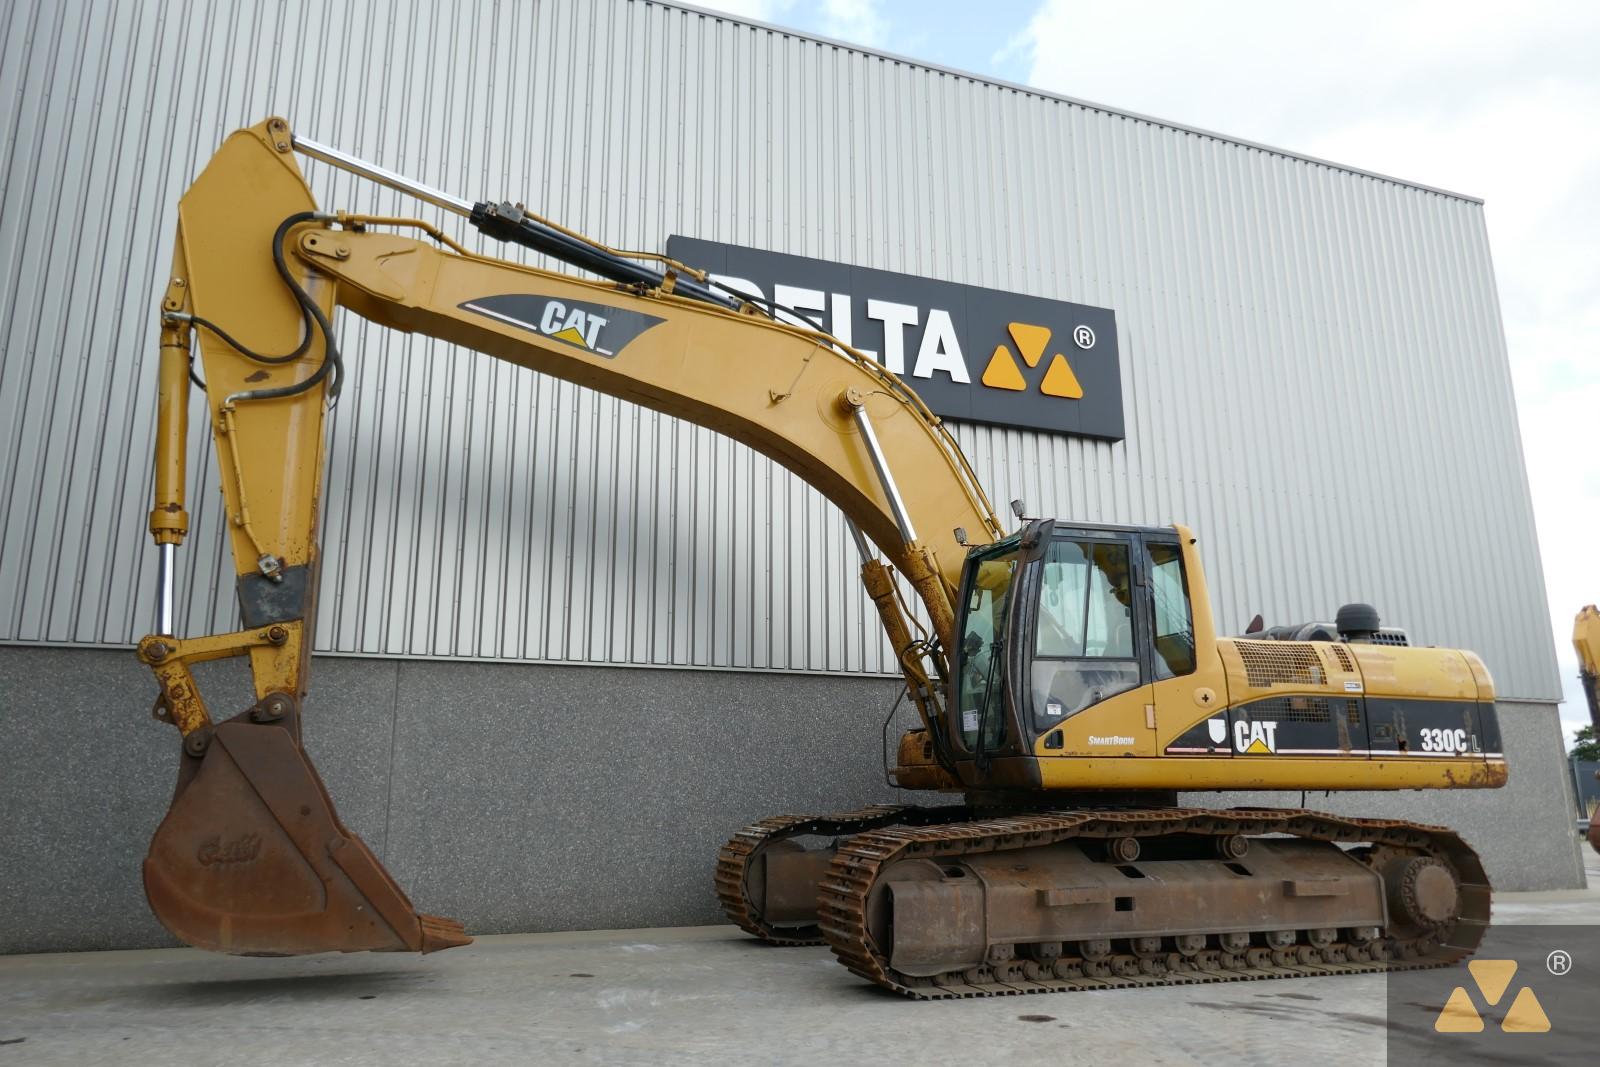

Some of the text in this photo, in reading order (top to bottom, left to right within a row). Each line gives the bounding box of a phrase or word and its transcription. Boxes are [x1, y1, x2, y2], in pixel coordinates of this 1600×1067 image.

[540, 300, 608, 350] CAT
[1234, 720, 1277, 753] CAT
[1419, 728, 1467, 753] 330C
